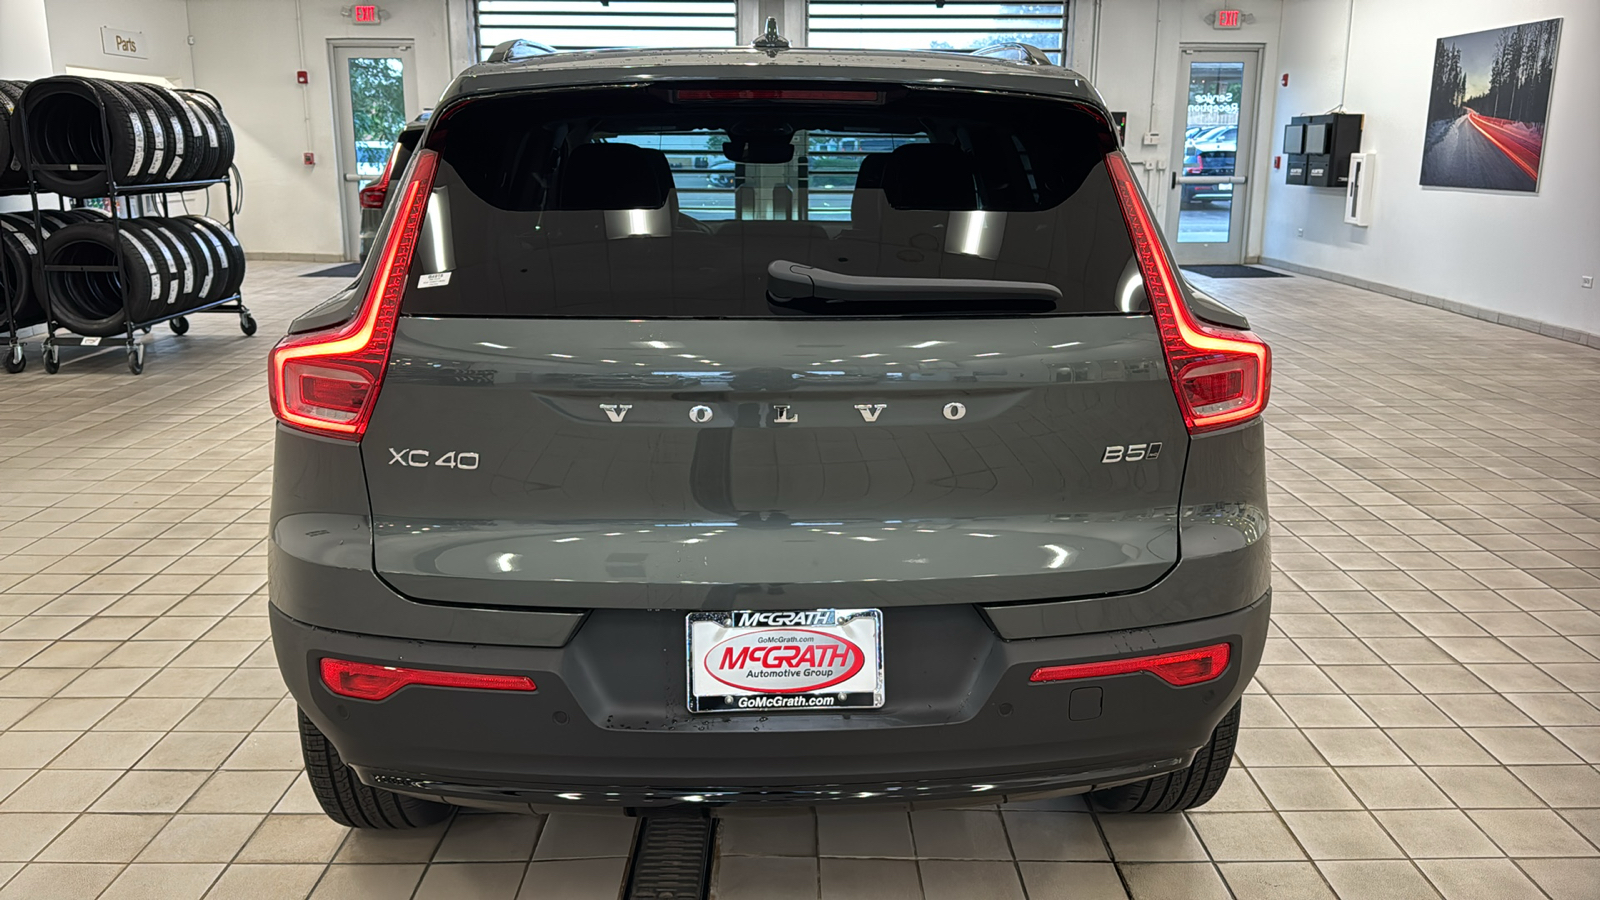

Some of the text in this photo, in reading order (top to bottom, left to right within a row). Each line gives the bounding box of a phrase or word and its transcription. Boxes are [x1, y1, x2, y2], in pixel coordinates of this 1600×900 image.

[355, 5, 375, 22] EXIT
[1219, 10, 1240, 26] EXIT
[115, 35, 137, 53] Parts
[1101, 443, 1147, 463] B5
[757, 635, 815, 645] GoMcGrath.com
[718, 644, 852, 670] McGRATH
[746, 668, 834, 679] Automotive Group
[738, 695, 834, 708] GoMcGrath.com
